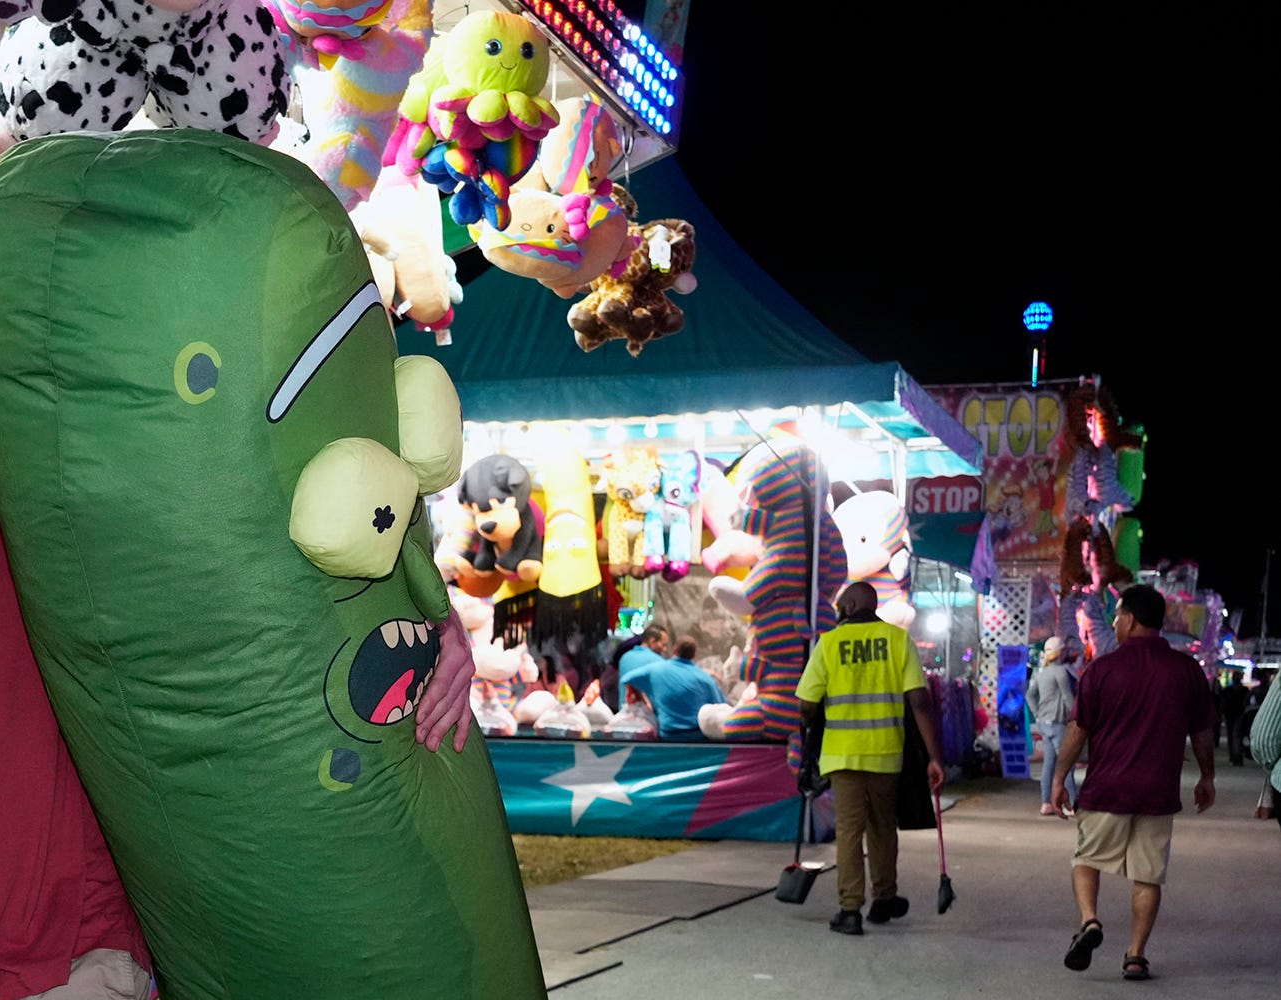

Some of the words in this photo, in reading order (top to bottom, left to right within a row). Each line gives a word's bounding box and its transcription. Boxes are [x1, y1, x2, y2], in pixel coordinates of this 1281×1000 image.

[963, 396, 1060, 457] STOP
[915, 486, 980, 513] STOP
[839, 637, 888, 666] FAIR
